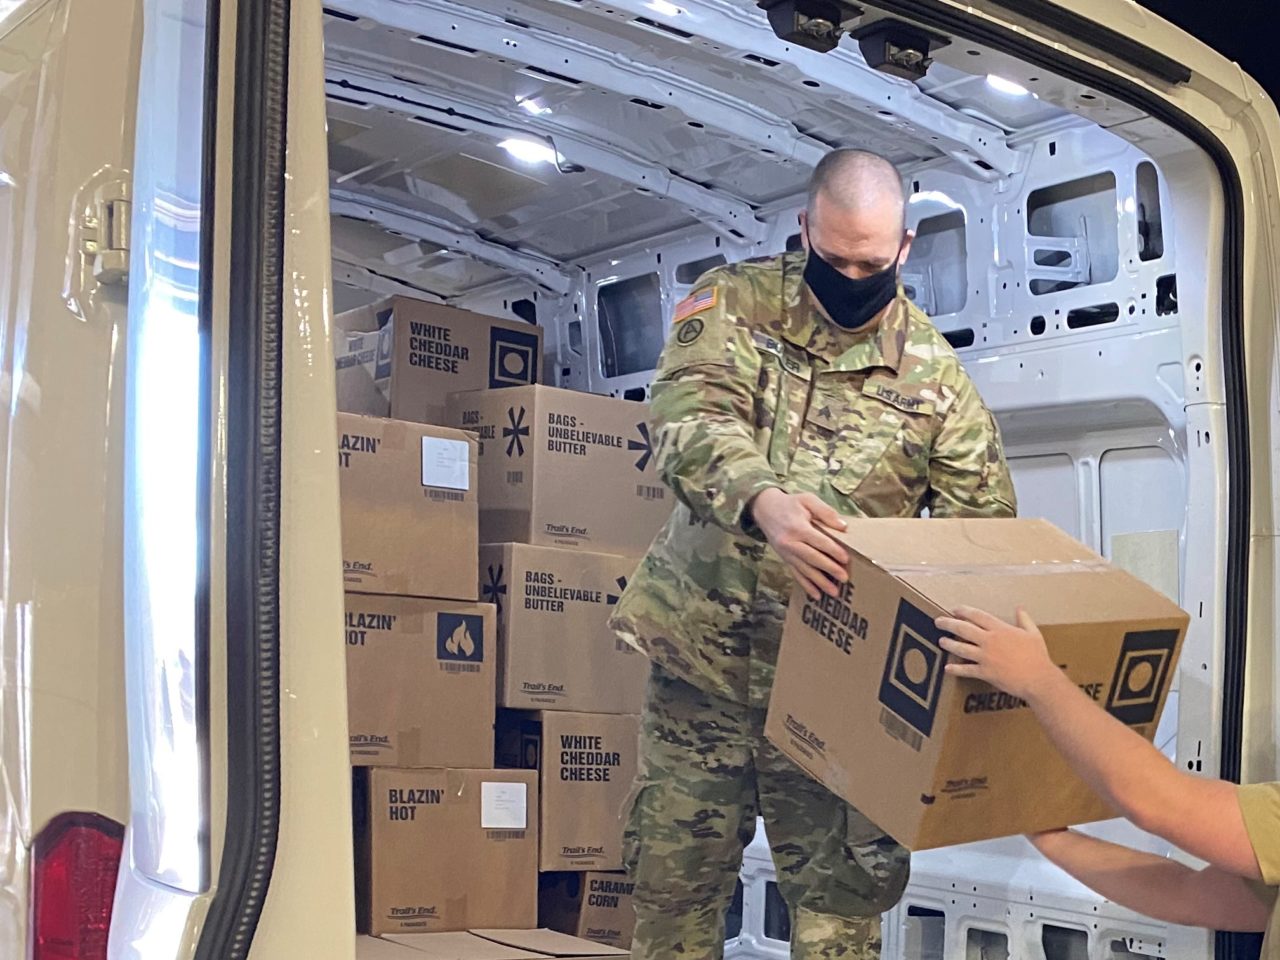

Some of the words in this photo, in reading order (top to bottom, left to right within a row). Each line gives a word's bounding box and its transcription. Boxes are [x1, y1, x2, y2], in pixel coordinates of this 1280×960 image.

[410, 321, 451, 342] WHITE
[410, 337, 469, 361] CHEDDAR
[409, 352, 459, 374] CHEESE
[462, 410, 480, 424] BAGS
[548, 412, 576, 428] BAGS
[339, 434, 381, 454] AZIN'
[548, 426, 623, 448] UNBELIEVABLE
[547, 440, 586, 456] BUTTER
[525, 570, 554, 586] BAGS
[525, 584, 602, 604] UNBELIEVABLE
[524, 598, 564, 612] BUTTER
[345, 612, 396, 630] LAZIN'
[345, 629, 367, 646] OT
[802, 604, 854, 656] CHEESE
[560, 734, 602, 750] WHITE
[560, 751, 620, 766] CHEDDAR
[560, 767, 610, 782] CHEESE
[388, 788, 444, 804] BLAZIN'
[388, 806, 417, 821] HOT
[588, 894, 619, 908] CORN
